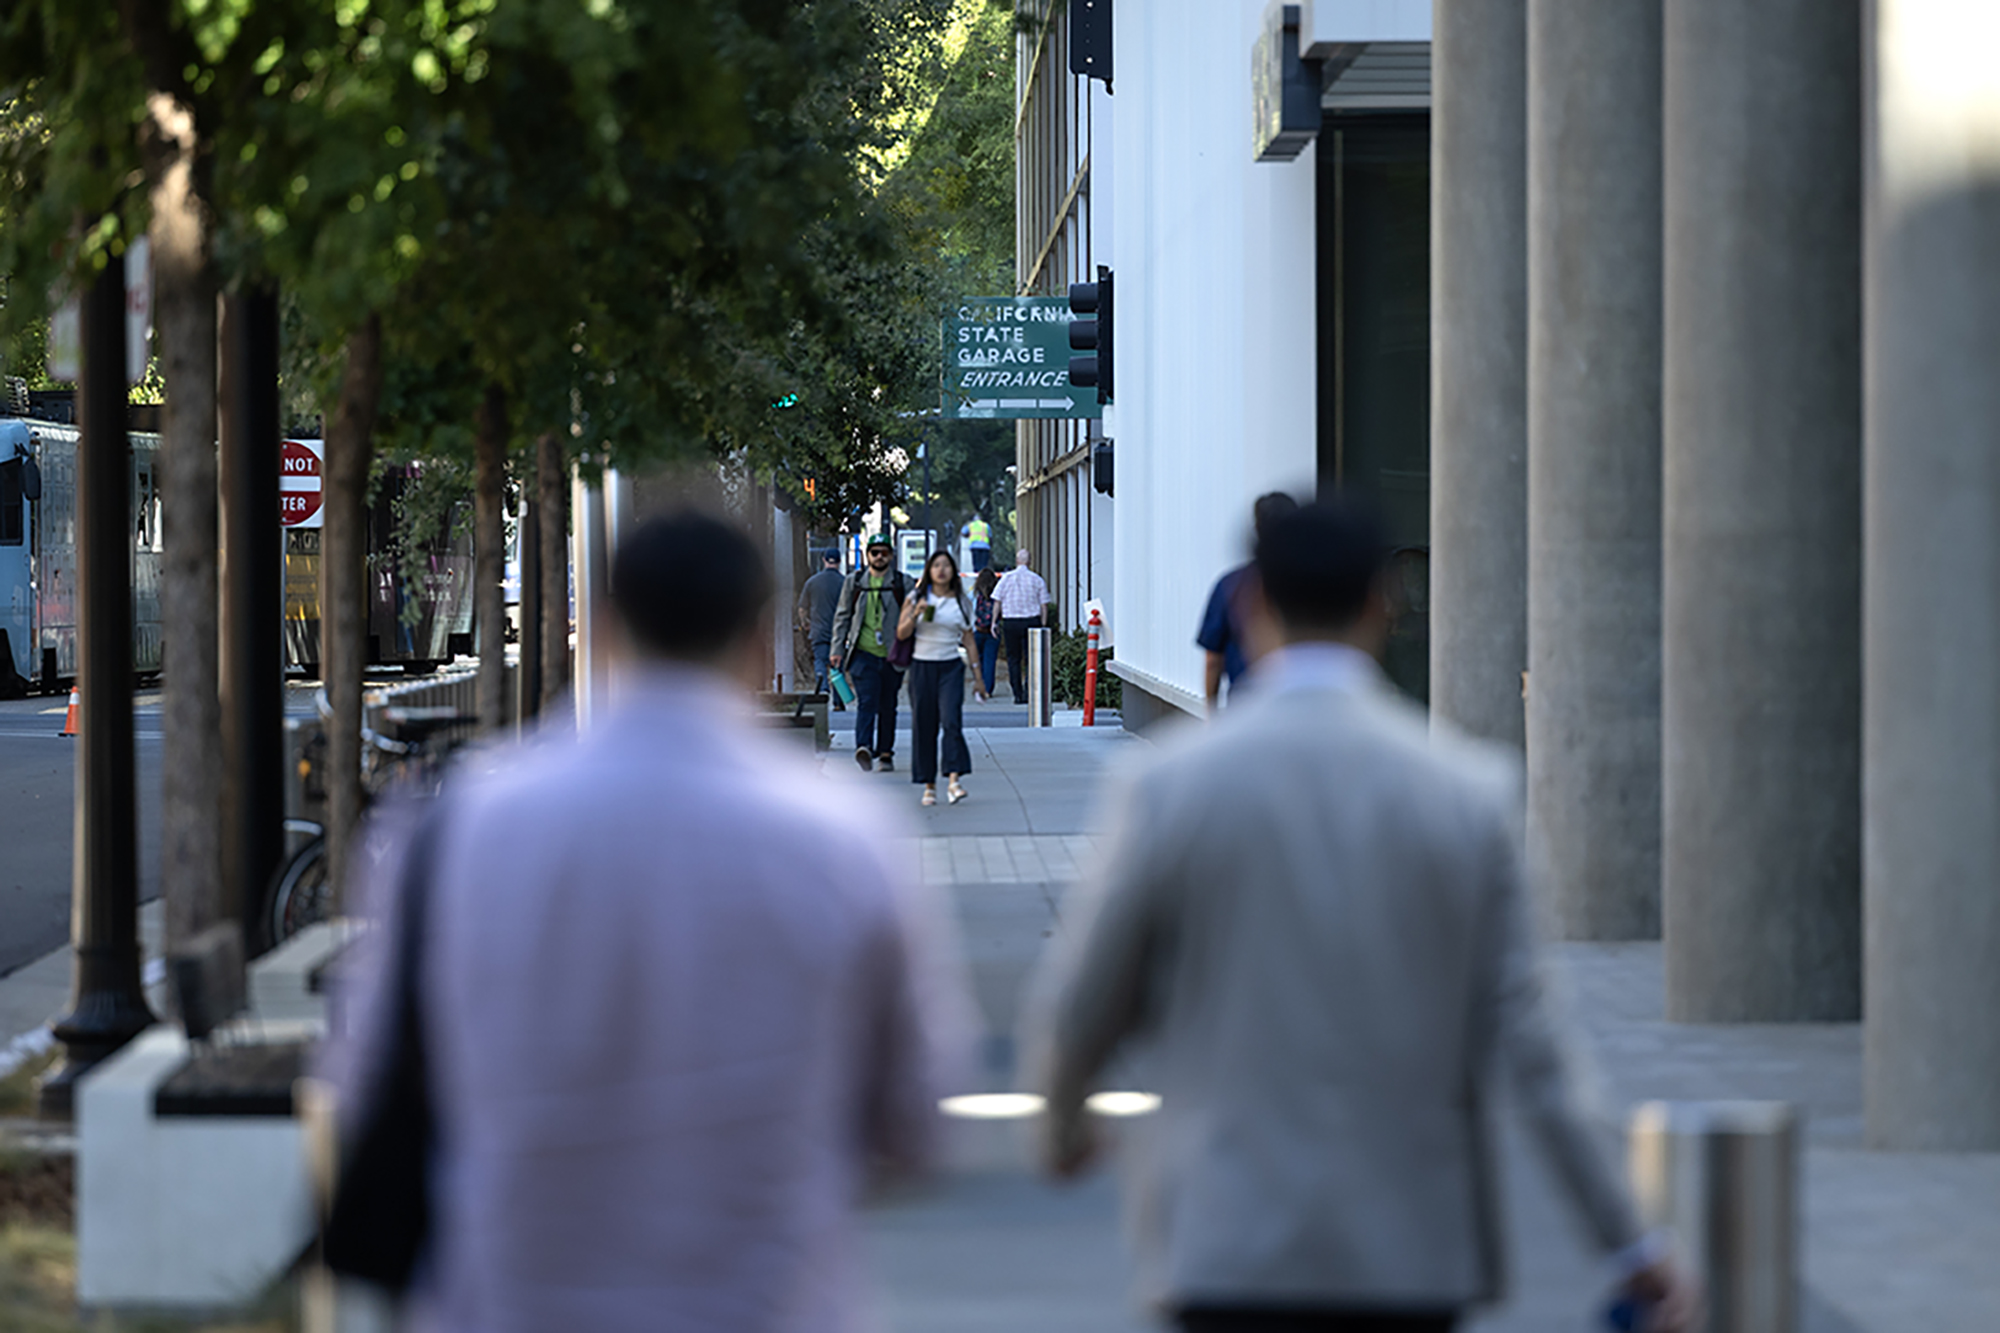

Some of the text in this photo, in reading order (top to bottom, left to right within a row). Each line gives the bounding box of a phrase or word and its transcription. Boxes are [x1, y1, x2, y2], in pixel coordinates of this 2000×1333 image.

[958, 327, 1024, 343] STATE
[958, 348, 1044, 363] GARAGE
[960, 371, 1069, 387] ENTRANCE
[284, 458, 314, 471] NOT
[281, 497, 306, 511] TER
